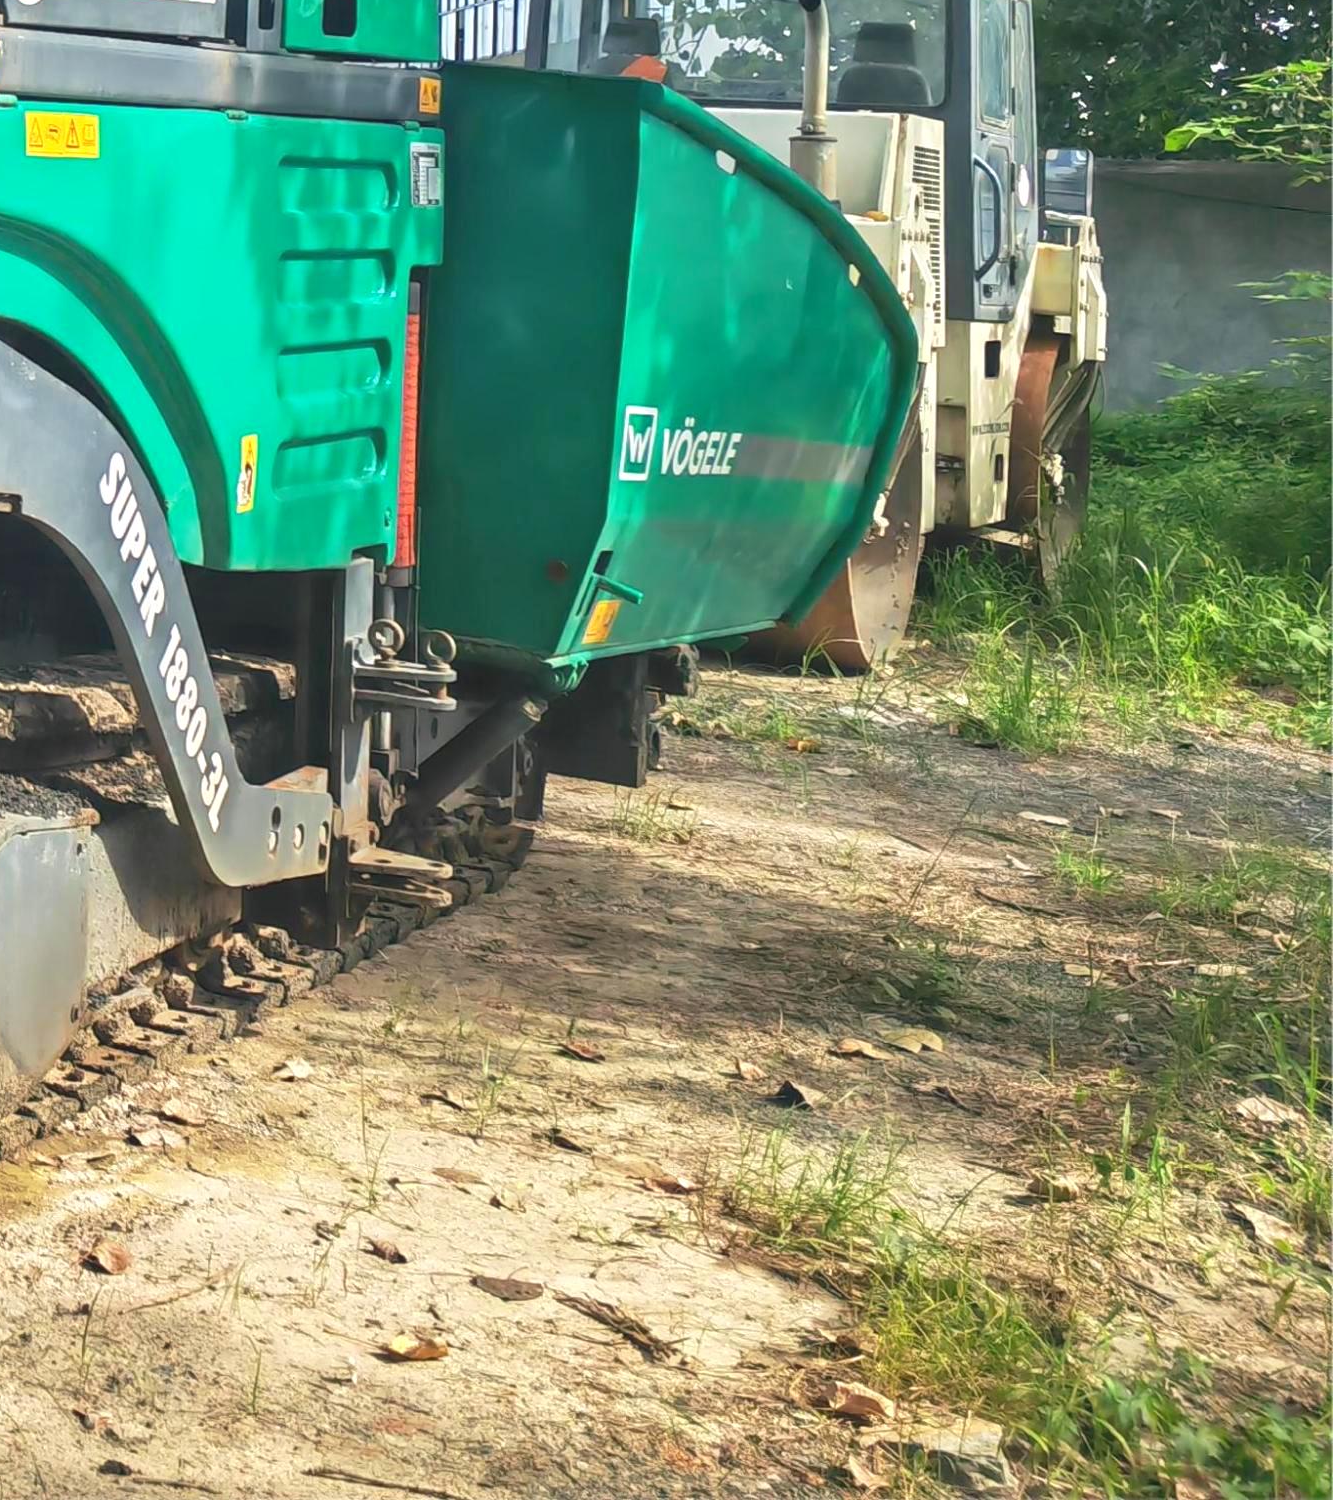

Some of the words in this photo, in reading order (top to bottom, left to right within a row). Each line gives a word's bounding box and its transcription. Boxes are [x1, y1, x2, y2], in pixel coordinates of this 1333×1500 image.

[661, 417, 743, 475] VÖGELE
[100, 452, 165, 638] SUPER
[159, 623, 229, 833] 1880-3L
